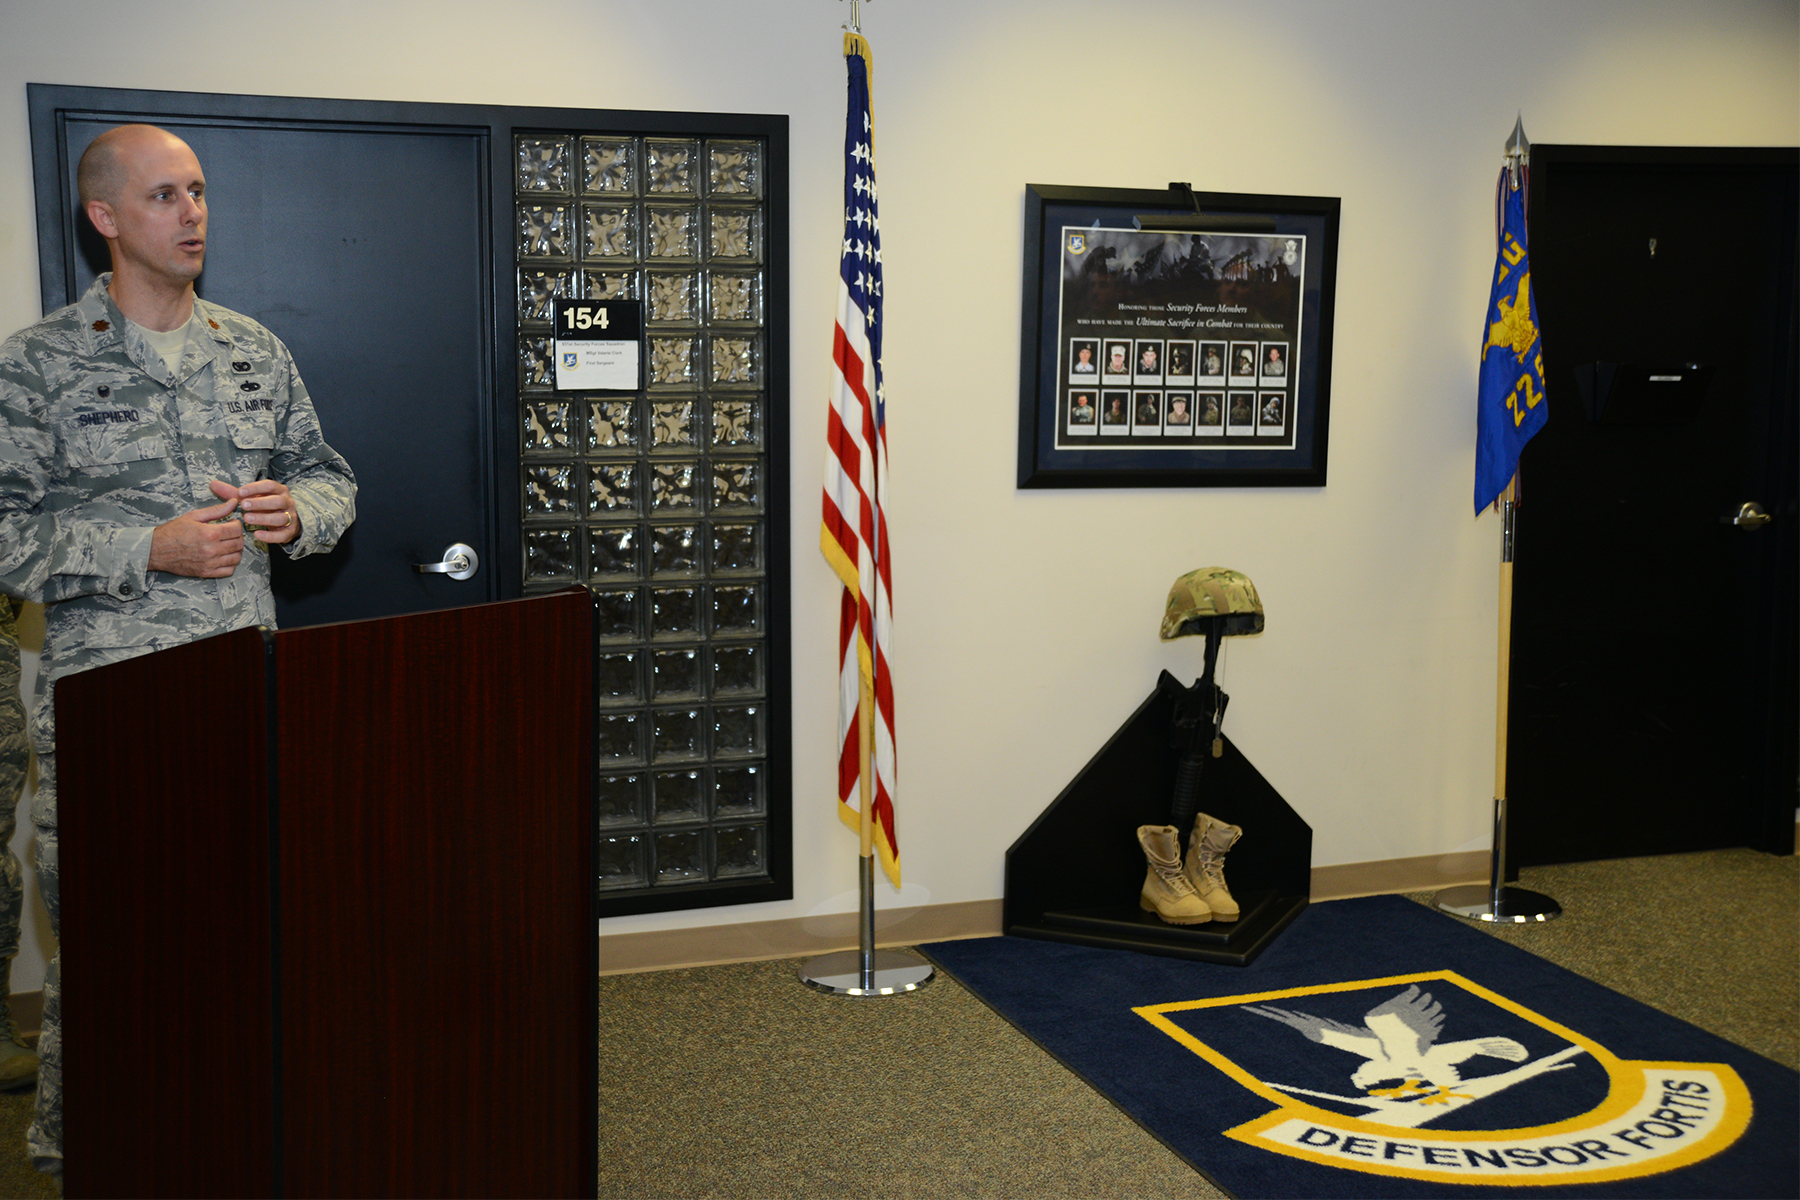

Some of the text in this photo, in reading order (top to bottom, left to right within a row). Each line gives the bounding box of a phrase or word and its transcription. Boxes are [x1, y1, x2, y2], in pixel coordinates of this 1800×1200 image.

[1166, 303, 1195, 315] Security
[1195, 303, 1216, 314] Forces
[1216, 304, 1248, 315] Members
[563, 307, 609, 330] 154
[1136, 317, 1166, 328] Ultimate
[1166, 318, 1195, 330] Sacrifice
[1196, 319, 1205, 328] in
[1206, 319, 1233, 329] Combat
[227, 401, 244, 413] U.S.
[244, 399, 260, 412] AIR
[79, 410, 139, 427] SHEPHERD
[1297, 1079, 1709, 1168] DEFENSOR FORTIS
